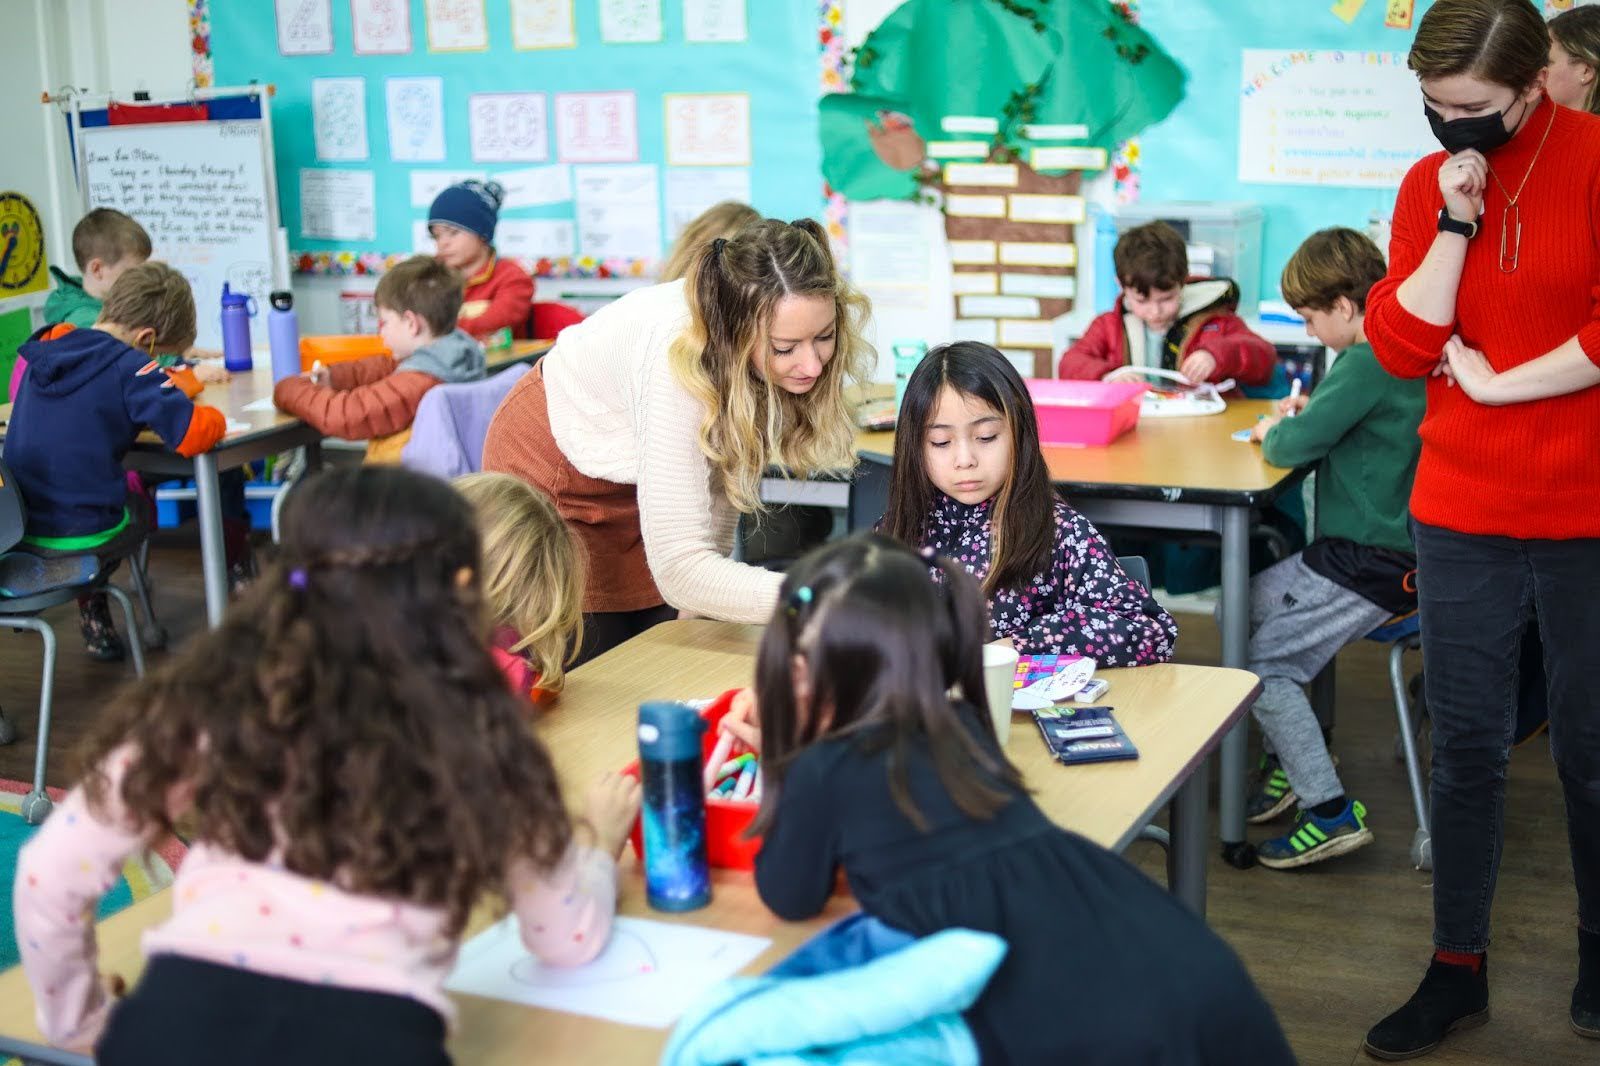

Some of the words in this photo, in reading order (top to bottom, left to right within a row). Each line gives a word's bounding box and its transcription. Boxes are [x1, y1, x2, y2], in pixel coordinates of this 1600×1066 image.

[320, 85, 359, 148] 8
[395, 85, 435, 147] 9
[478, 98, 539, 151] 10
[566, 98, 627, 148] 11
[677, 101, 738, 153] 12
